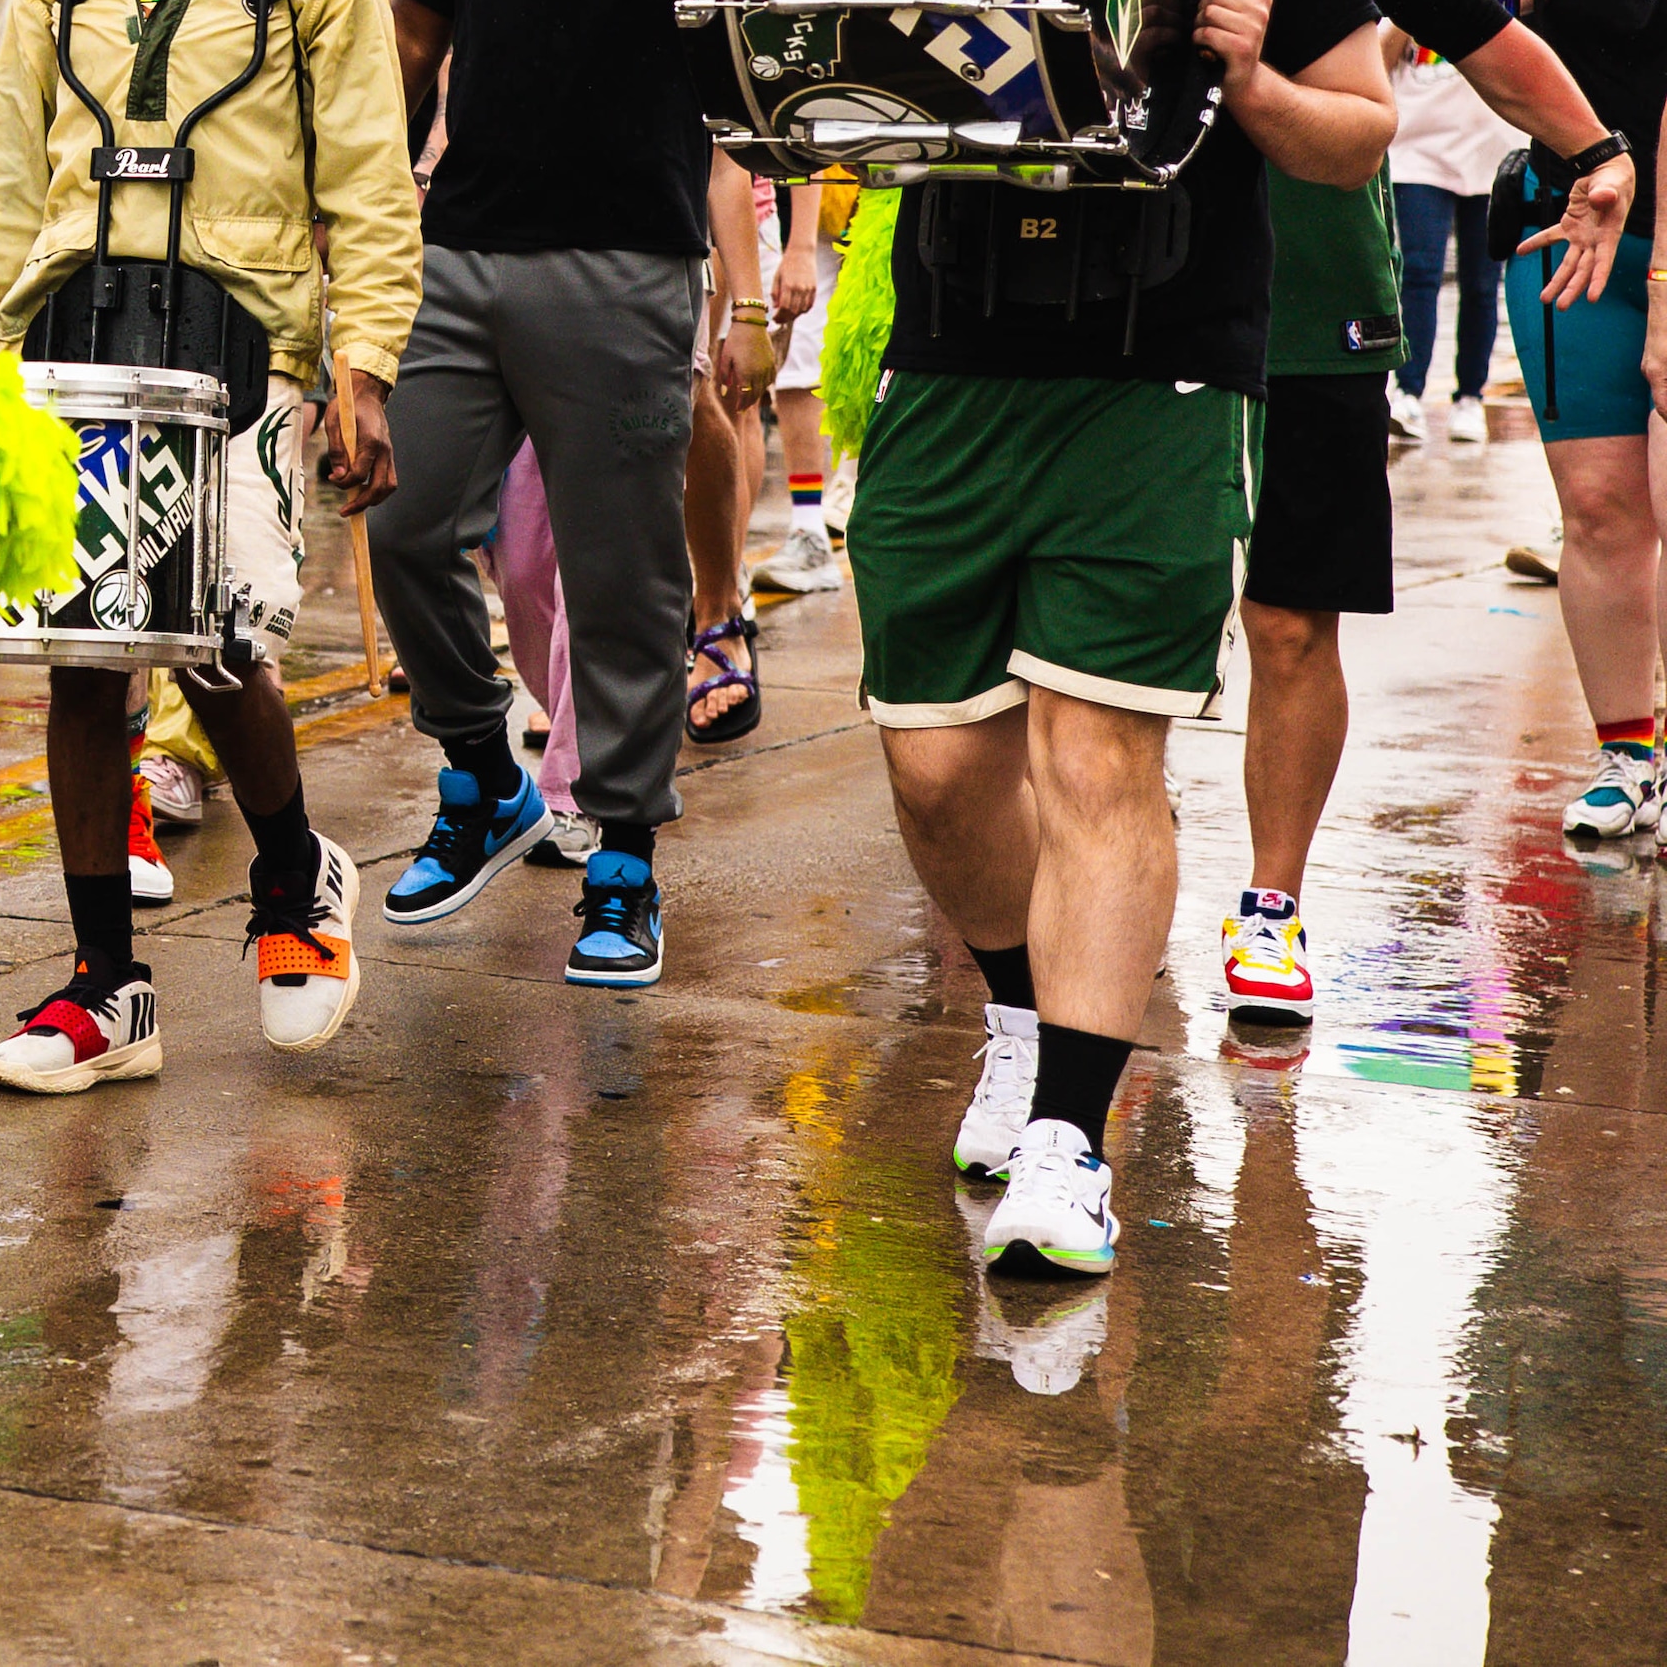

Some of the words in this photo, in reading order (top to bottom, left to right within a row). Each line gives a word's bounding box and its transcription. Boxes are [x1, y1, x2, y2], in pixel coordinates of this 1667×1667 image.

[782, 13, 817, 62] CKS
[106, 148, 171, 178] Pearl
[1020, 218, 1058, 239] B2
[137, 482, 196, 576] MILWAUK
